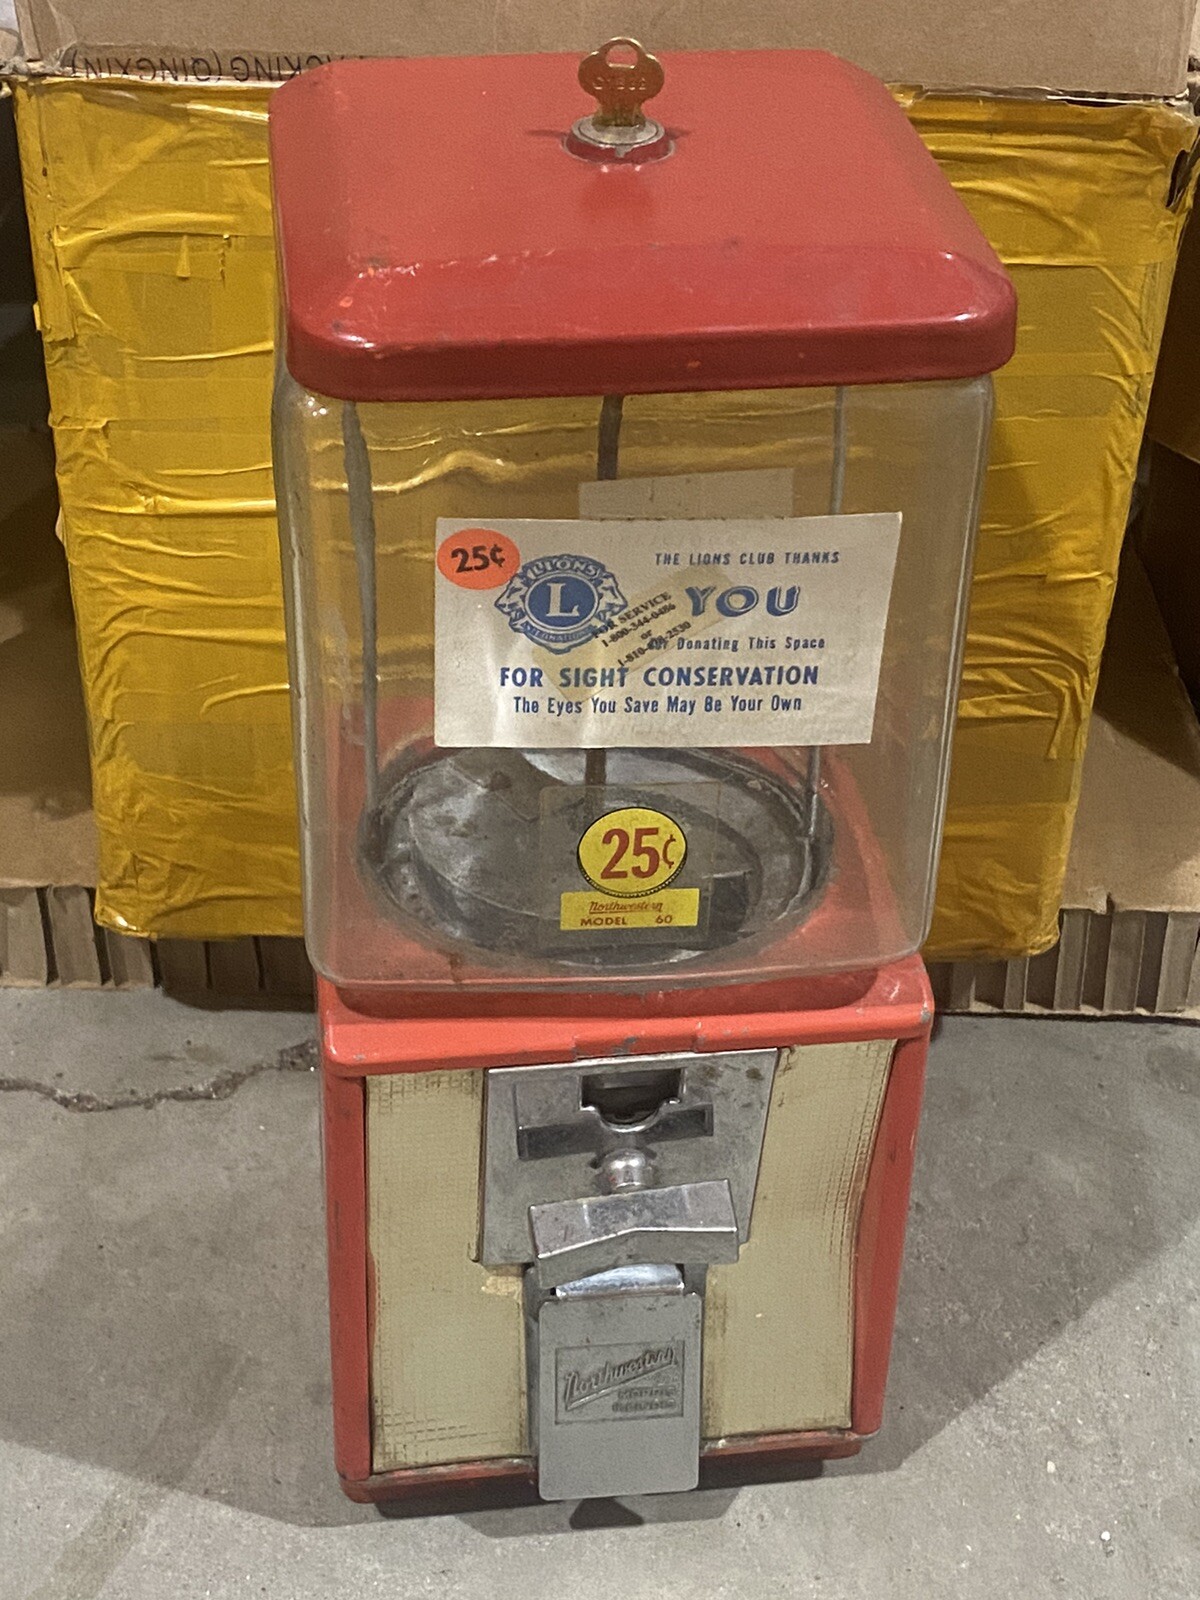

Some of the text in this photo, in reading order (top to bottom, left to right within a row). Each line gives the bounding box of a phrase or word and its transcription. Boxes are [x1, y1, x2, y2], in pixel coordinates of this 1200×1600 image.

[451, 544, 506, 573] 25¢
[531, 557, 598, 578] LIONS
[655, 551, 840, 566] THE LIONS CLUB THANKS
[546, 582, 580, 617] L
[617, 591, 673, 625] SERVICE
[684, 584, 801, 618] YOU
[640, 629, 654, 641] or
[676, 636, 740, 652] Donating
[748, 636, 777, 650] This
[785, 636, 826, 651] Space
[499, 664, 820, 688] FOR SIGHT CONSERVATION
[512, 694, 803, 717] The Eyes You Save May Be Your Own
[600, 827, 677, 880] 25¢
[580, 914, 674, 927] MODEL 60
